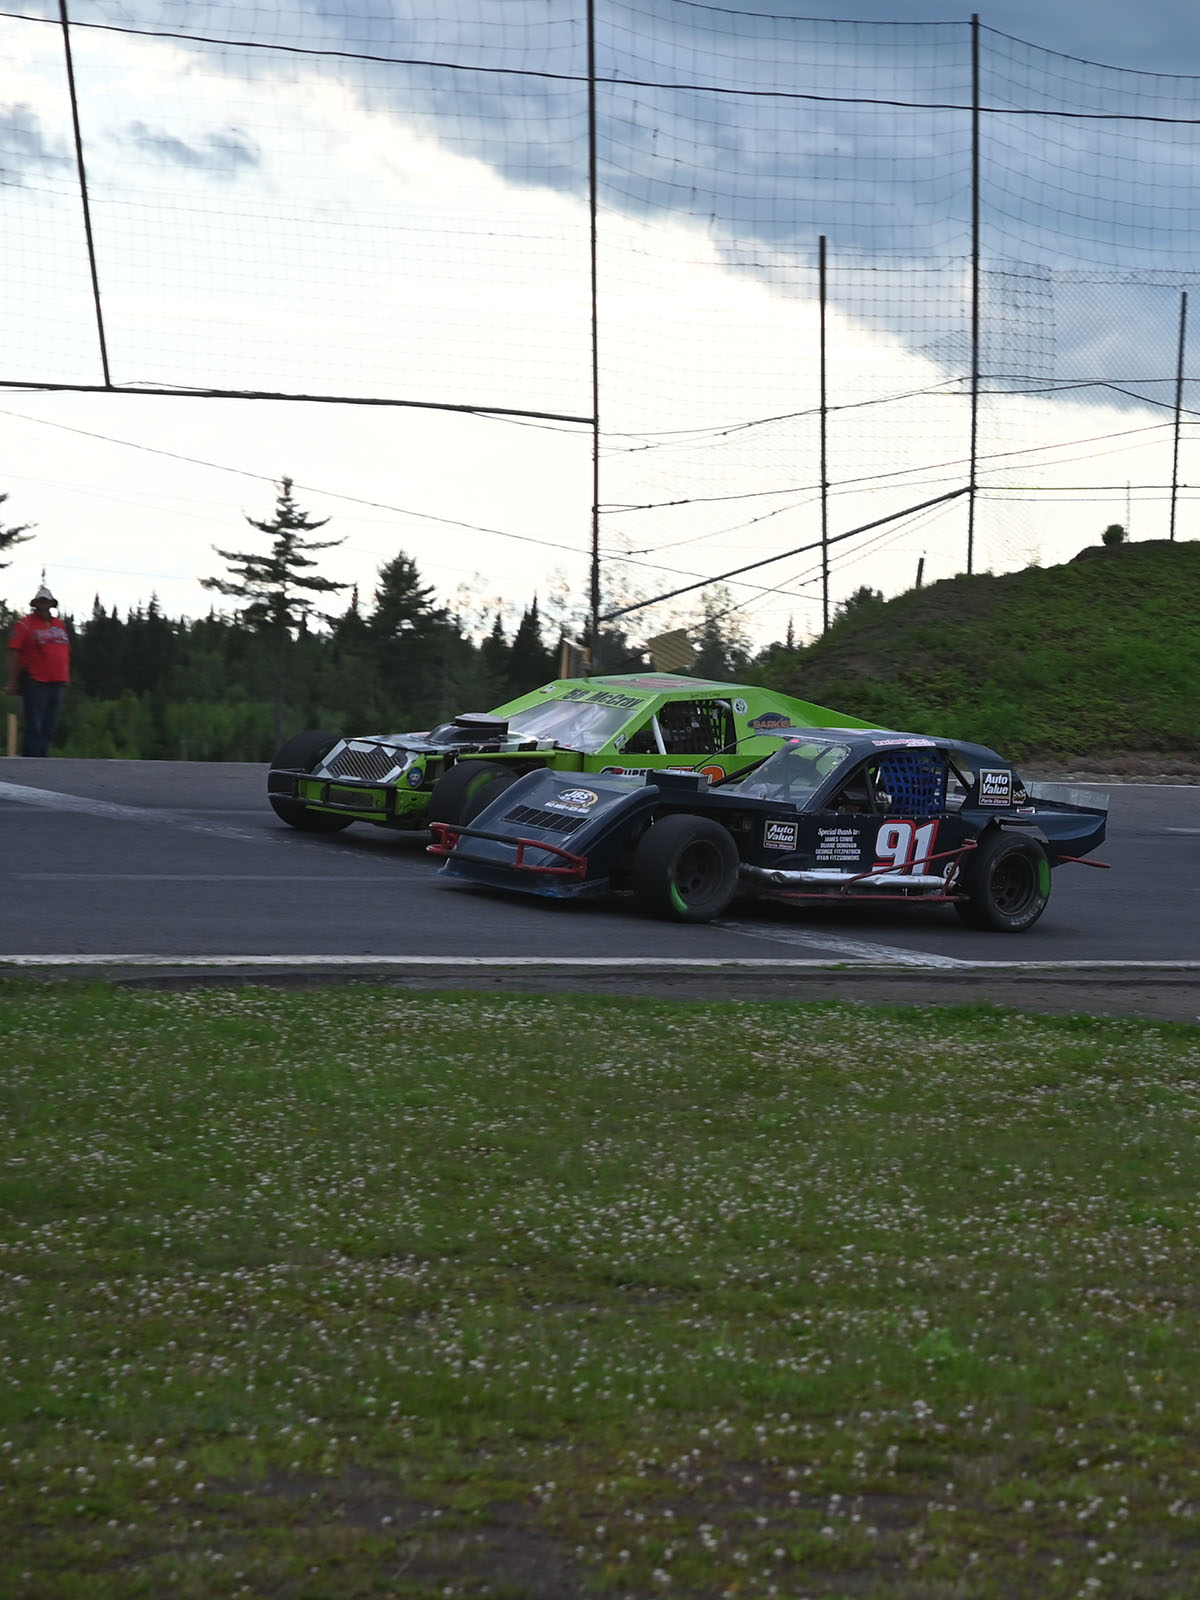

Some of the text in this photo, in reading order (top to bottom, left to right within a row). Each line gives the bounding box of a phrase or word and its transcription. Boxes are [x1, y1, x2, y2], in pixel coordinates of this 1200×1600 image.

[586, 691, 644, 708] McCray
[985, 774, 1008, 784] Auto
[983, 784, 1008, 794] Value
[770, 824, 794, 834] Auto
[817, 828, 836, 837] Special
[767, 832, 794, 842] Value
[872, 820, 940, 876] 91
